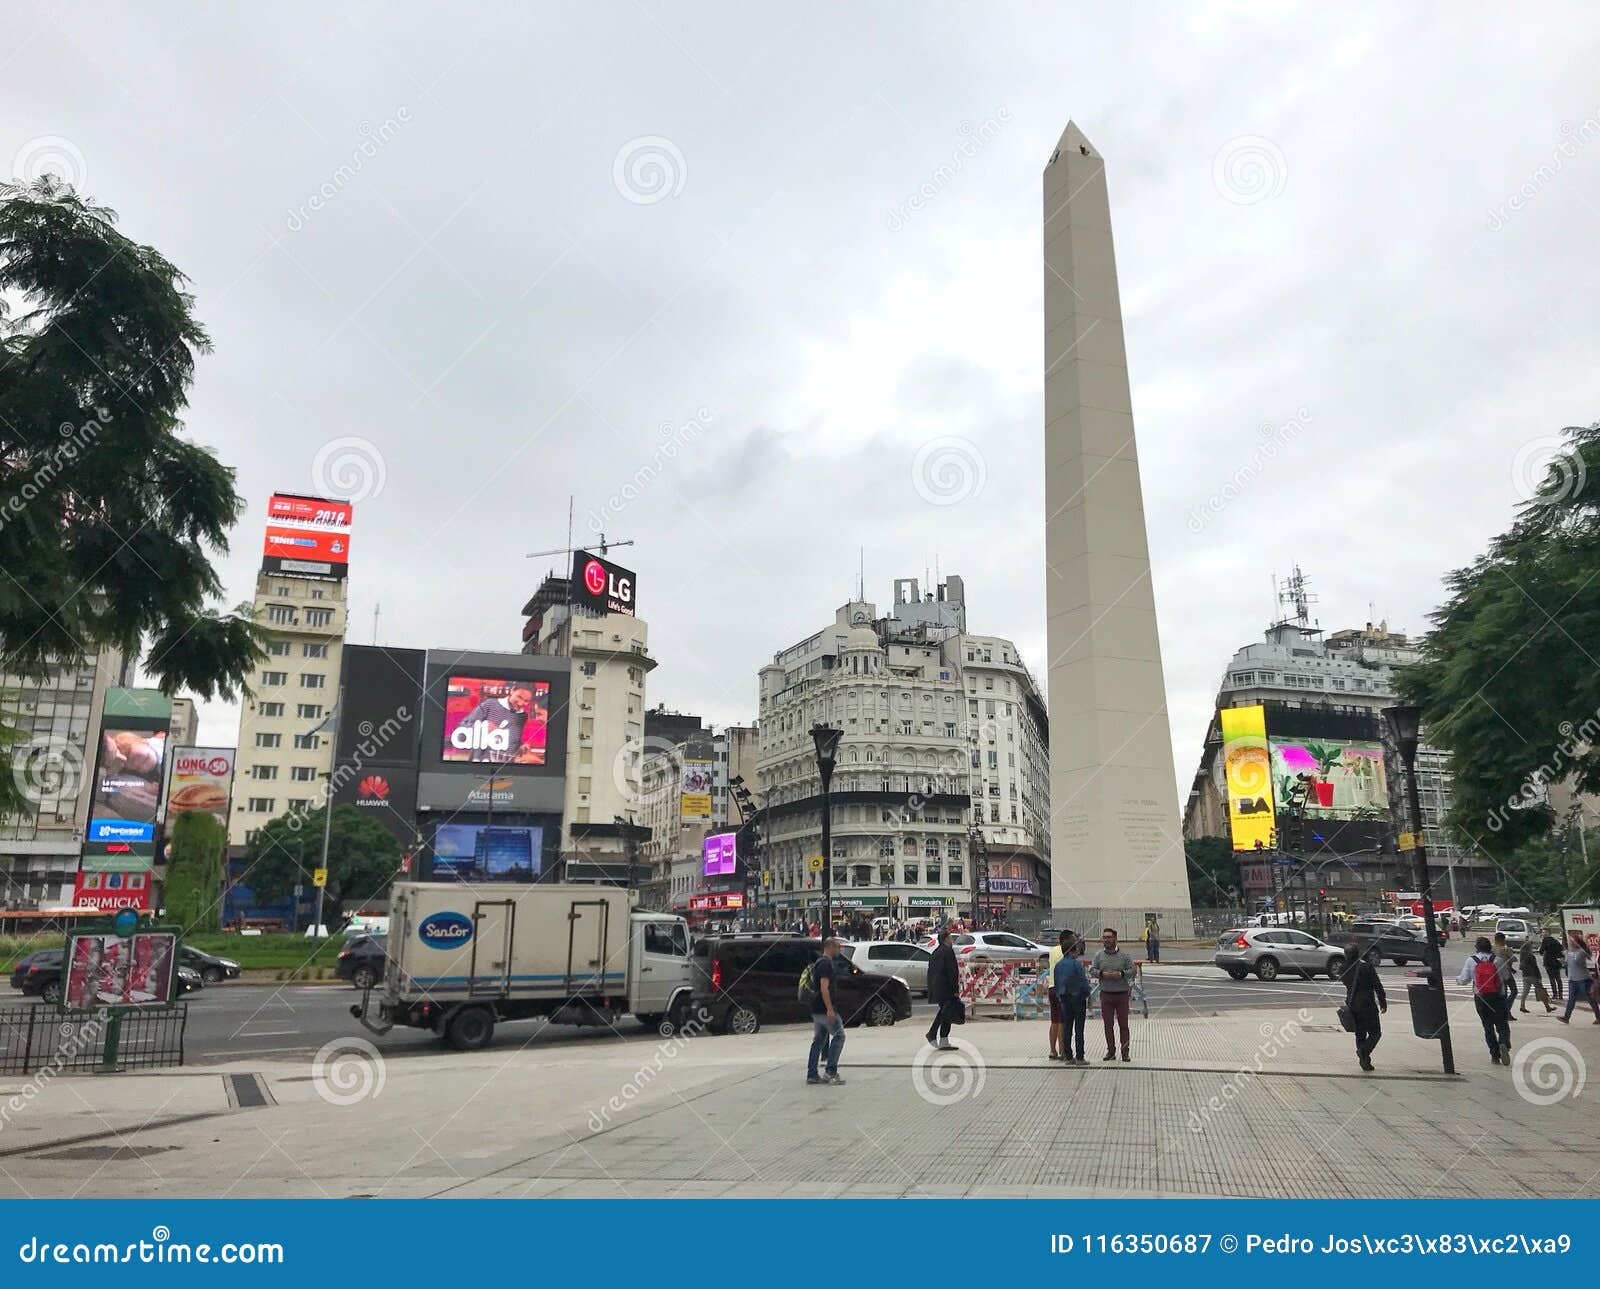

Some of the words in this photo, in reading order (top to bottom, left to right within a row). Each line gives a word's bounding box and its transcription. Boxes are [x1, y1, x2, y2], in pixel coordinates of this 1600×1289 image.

[608, 572, 631, 602] LG
[621, 605, 633, 615] Good
[450, 719, 510, 751] allá
[176, 758, 206, 770] LONG
[78, 896, 141, 909] PRIMICIA
[1571, 914, 1594, 924] mini
[426, 923, 469, 937] SanCor
